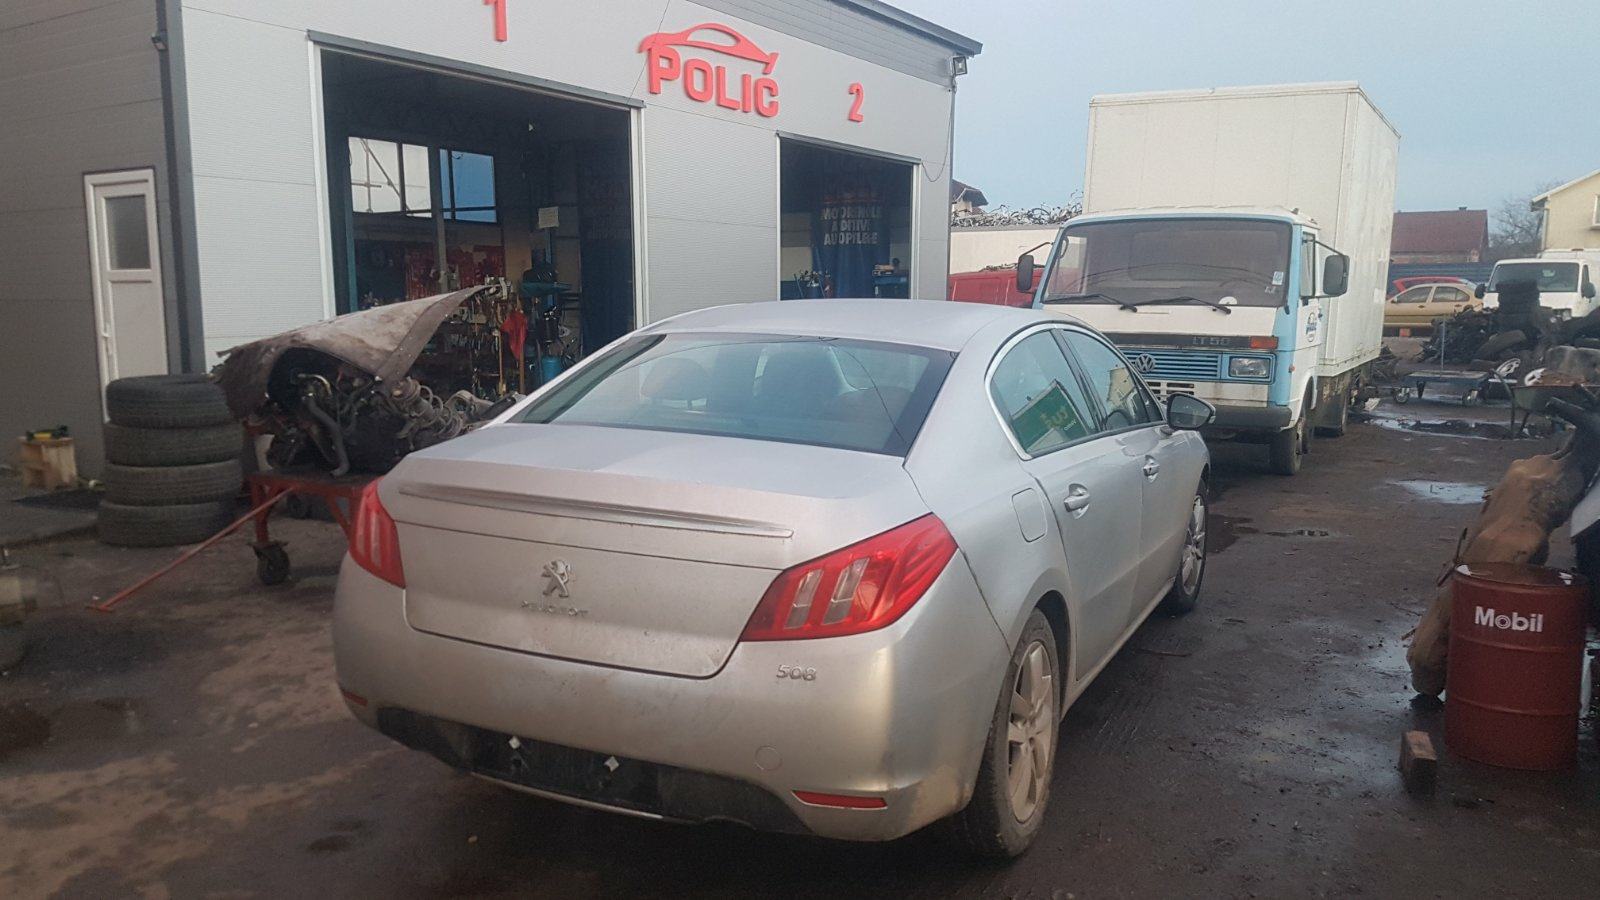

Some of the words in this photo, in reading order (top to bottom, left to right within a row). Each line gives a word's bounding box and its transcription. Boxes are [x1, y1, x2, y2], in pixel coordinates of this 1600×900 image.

[484, 0, 507, 42] 1
[848, 82, 864, 123] 2
[1475, 606, 1543, 632] Mobil
[776, 664, 818, 682] 508
